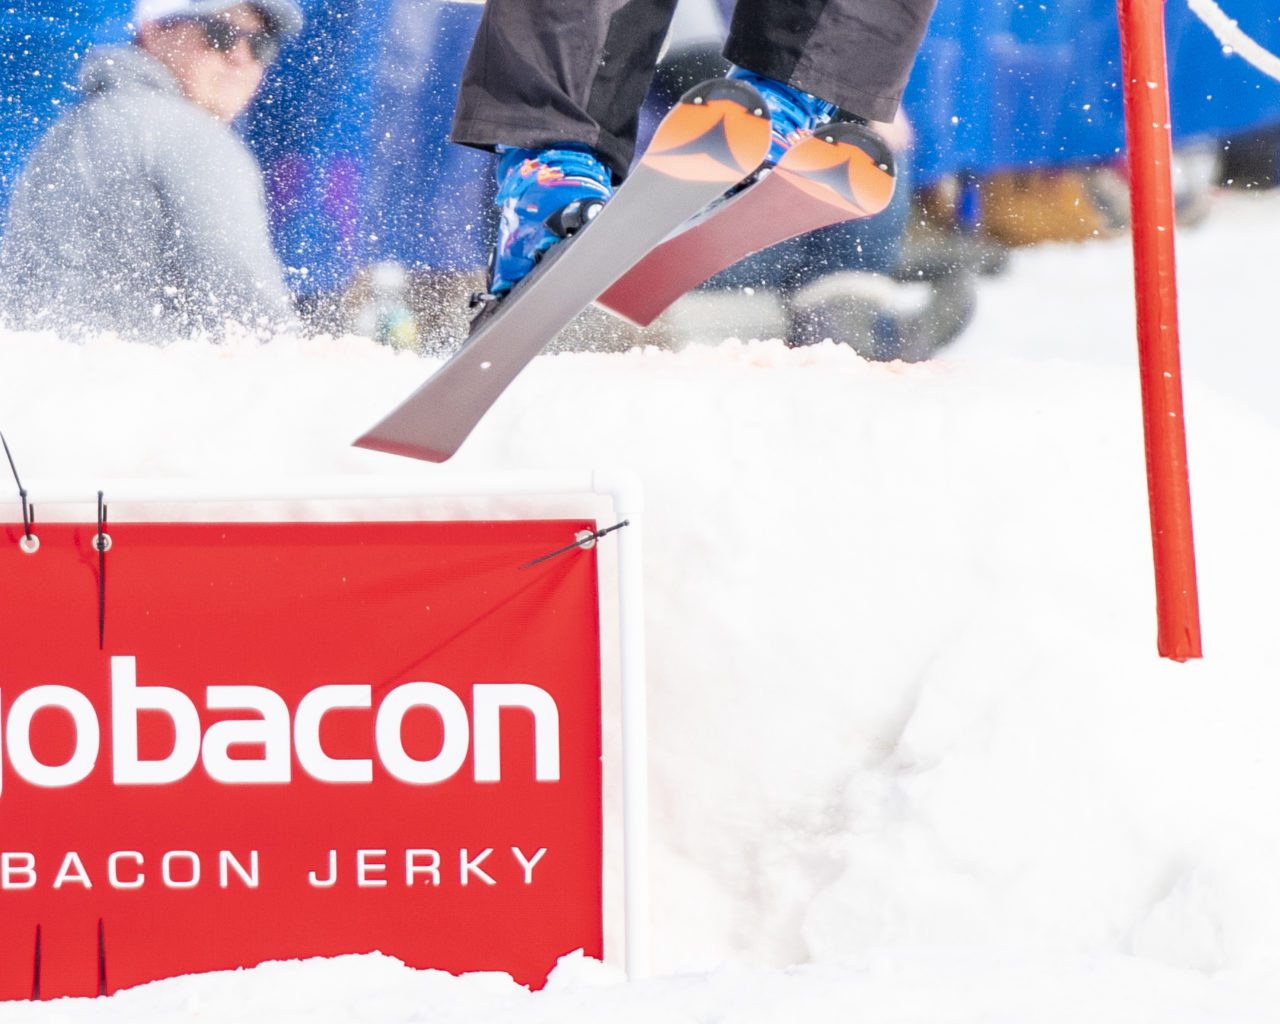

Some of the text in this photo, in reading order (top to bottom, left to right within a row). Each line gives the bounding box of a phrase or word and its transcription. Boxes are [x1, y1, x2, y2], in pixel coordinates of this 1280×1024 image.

[0, 655, 561, 797] obacon
[1, 846, 547, 890] BACON JERKY
